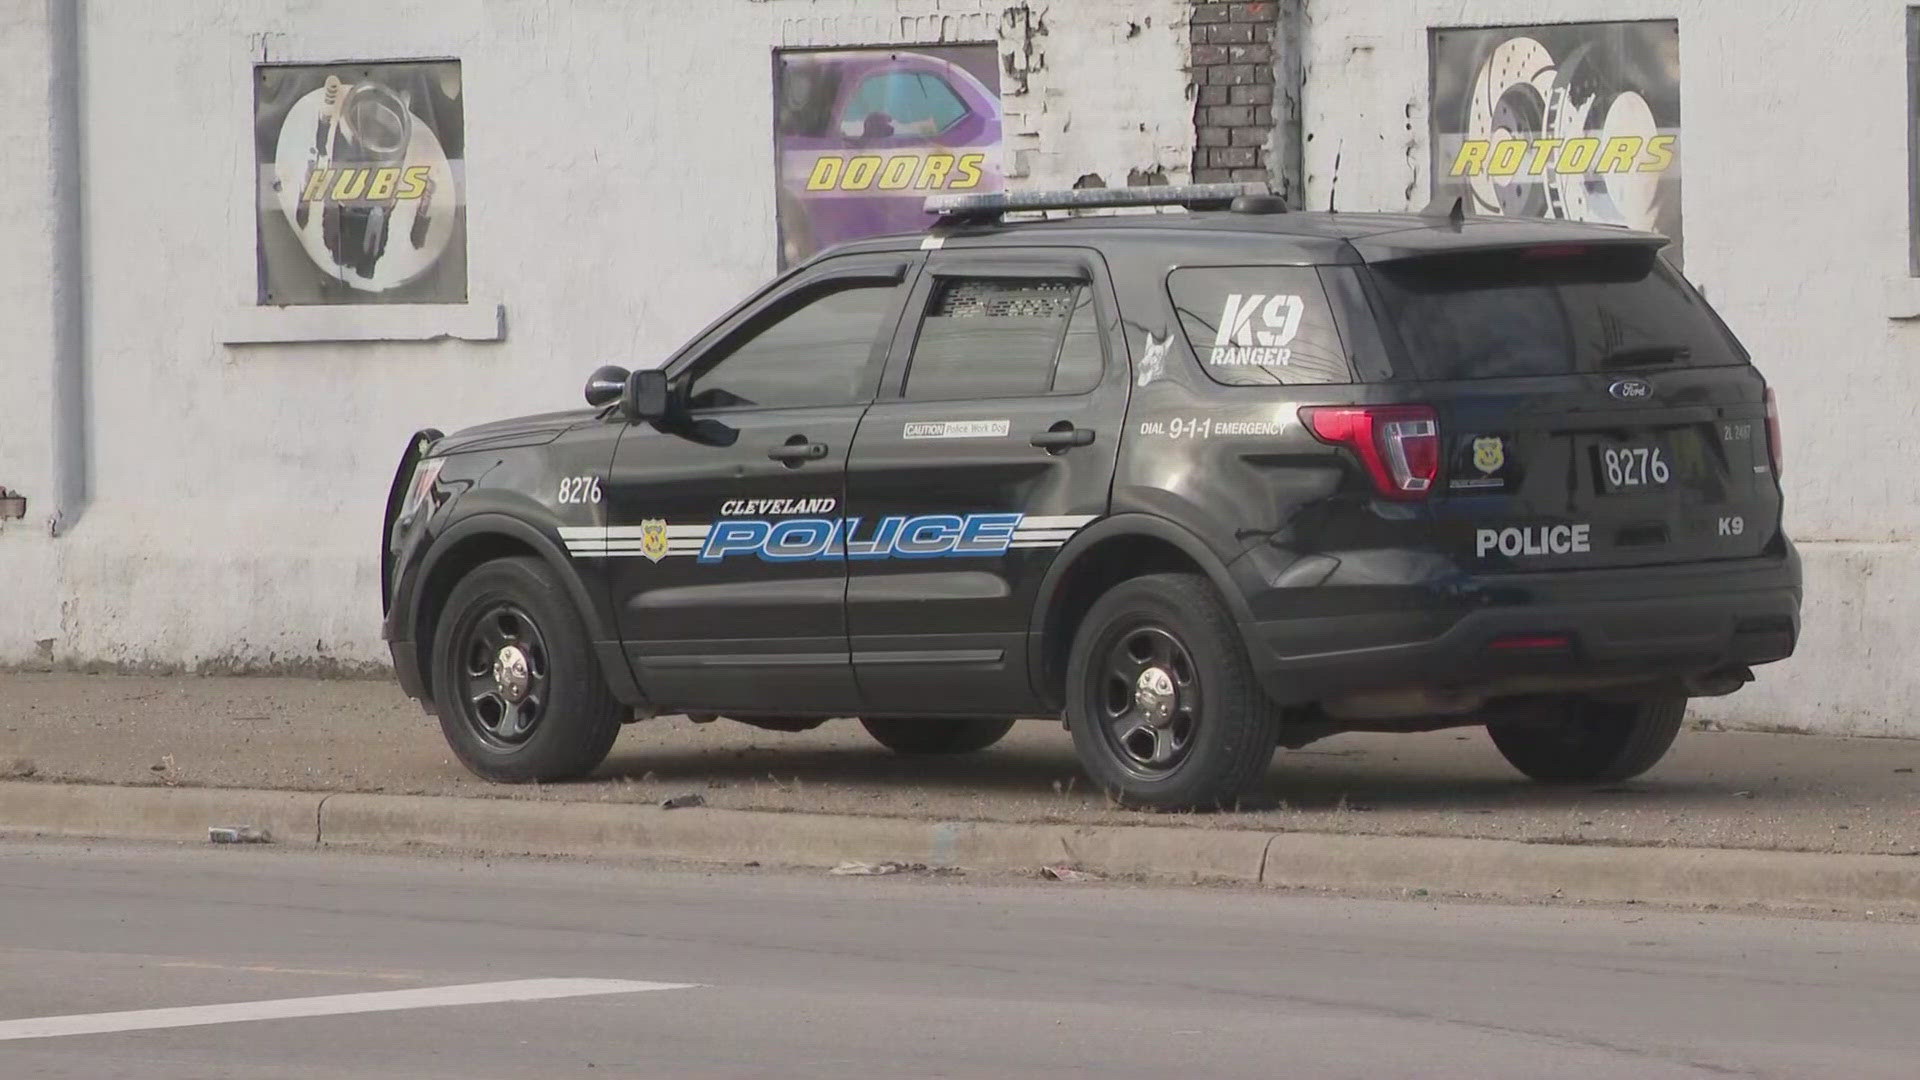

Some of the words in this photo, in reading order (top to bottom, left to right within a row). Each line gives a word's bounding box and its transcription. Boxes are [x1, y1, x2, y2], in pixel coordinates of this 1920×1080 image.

[1449, 135, 1677, 177] ROTORS
[302, 165, 431, 201] HUBS
[806, 153, 985, 191] DOORS
[1215, 293, 1304, 346] K9
[1210, 346, 1291, 366] RANGER
[1622, 382, 1646, 397] Ford
[906, 424, 944, 436] CAUTION
[1140, 422, 1165, 435] DIAL
[1169, 417, 1211, 439] 9-1-1
[1214, 422, 1286, 436] EMERGENCY
[1605, 447, 1670, 486] 8276
[558, 475, 602, 504] 8276
[721, 498, 836, 516] CLEVELAND
[697, 512, 1024, 564] POLICE
[1476, 524, 1591, 558] POLICE
[1718, 516, 1744, 536] K9
